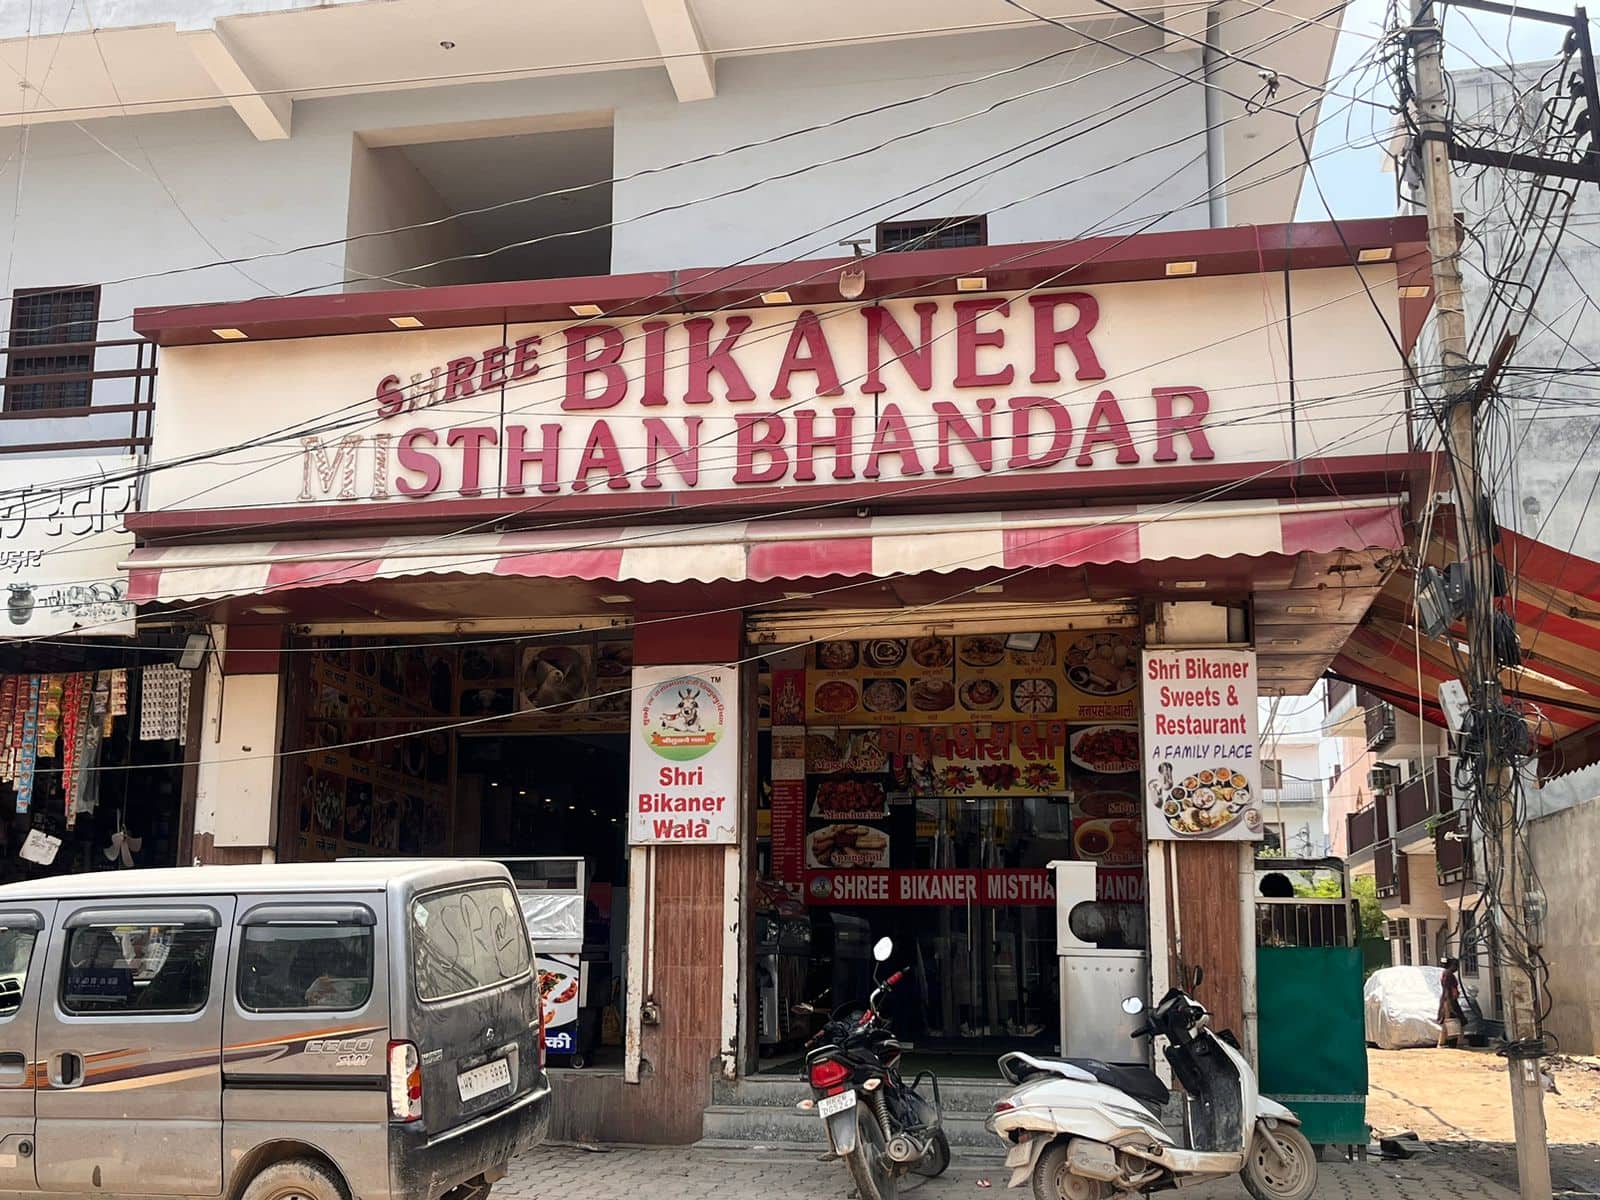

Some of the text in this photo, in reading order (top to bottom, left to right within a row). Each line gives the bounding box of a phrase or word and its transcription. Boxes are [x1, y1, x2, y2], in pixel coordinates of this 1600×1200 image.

[375, 292, 1106, 418] SHREE BIKANER
[298, 386, 1215, 501] MISTHAN BHANDAR
[1148, 657, 1249, 680] Shri Bikaner
[1160, 684, 1239, 708] Sweets &
[1155, 713, 1248, 735] Restaurant
[1152, 744, 1254, 760] A FAMILY PLACE
[659, 766, 703, 787] Shri
[638, 793, 726, 813] Bikaner
[653, 819, 708, 839] Wala
[833, 874, 889, 899] SHREE
[900, 874, 977, 899] BIKANER
[303, 1039, 373, 1054] EECO
